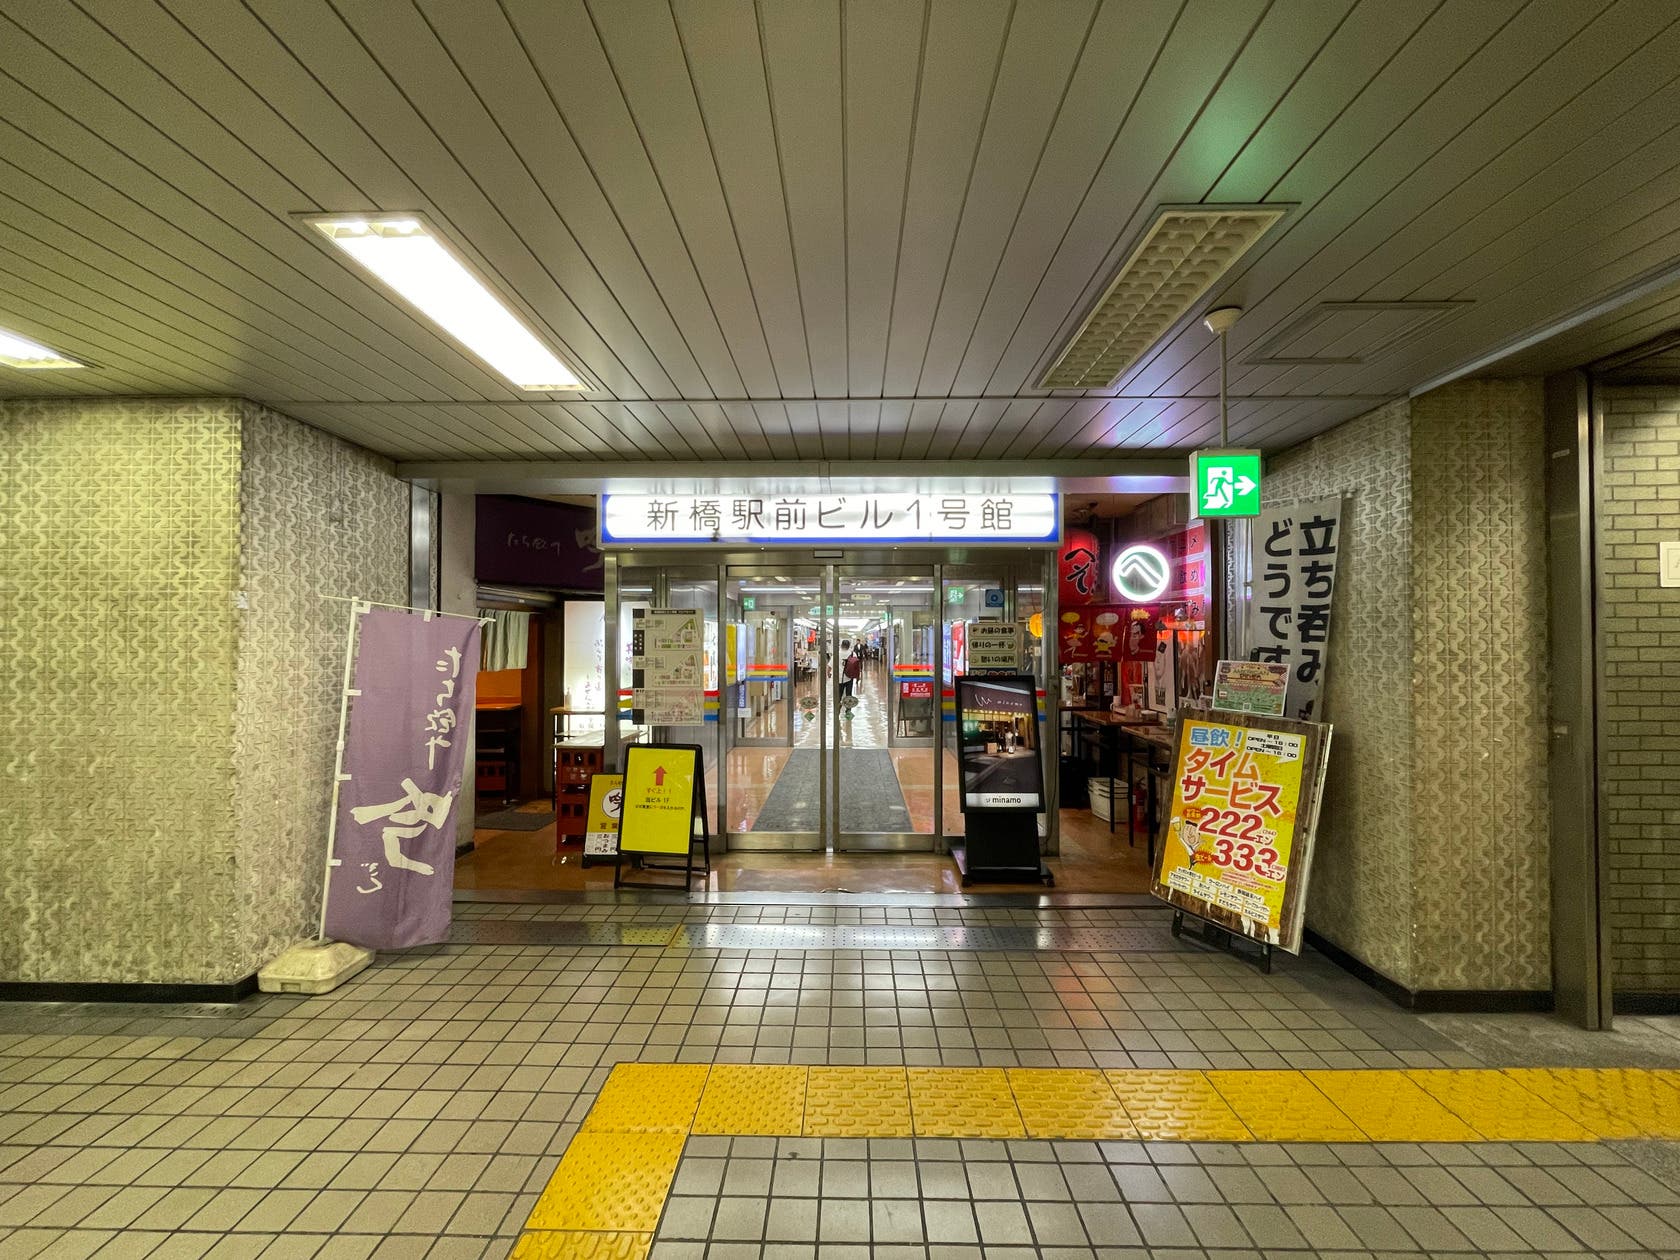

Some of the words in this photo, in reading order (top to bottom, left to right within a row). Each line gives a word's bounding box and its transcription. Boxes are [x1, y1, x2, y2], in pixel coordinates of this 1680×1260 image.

[647, 497, 1014, 531] 新橋駅前ビル1号館
[1064, 547, 1097, 595] へそ
[1186, 747, 1259, 781] タイム
[992, 796, 1022, 804] minamo
[1181, 774, 1281, 815] サービス
